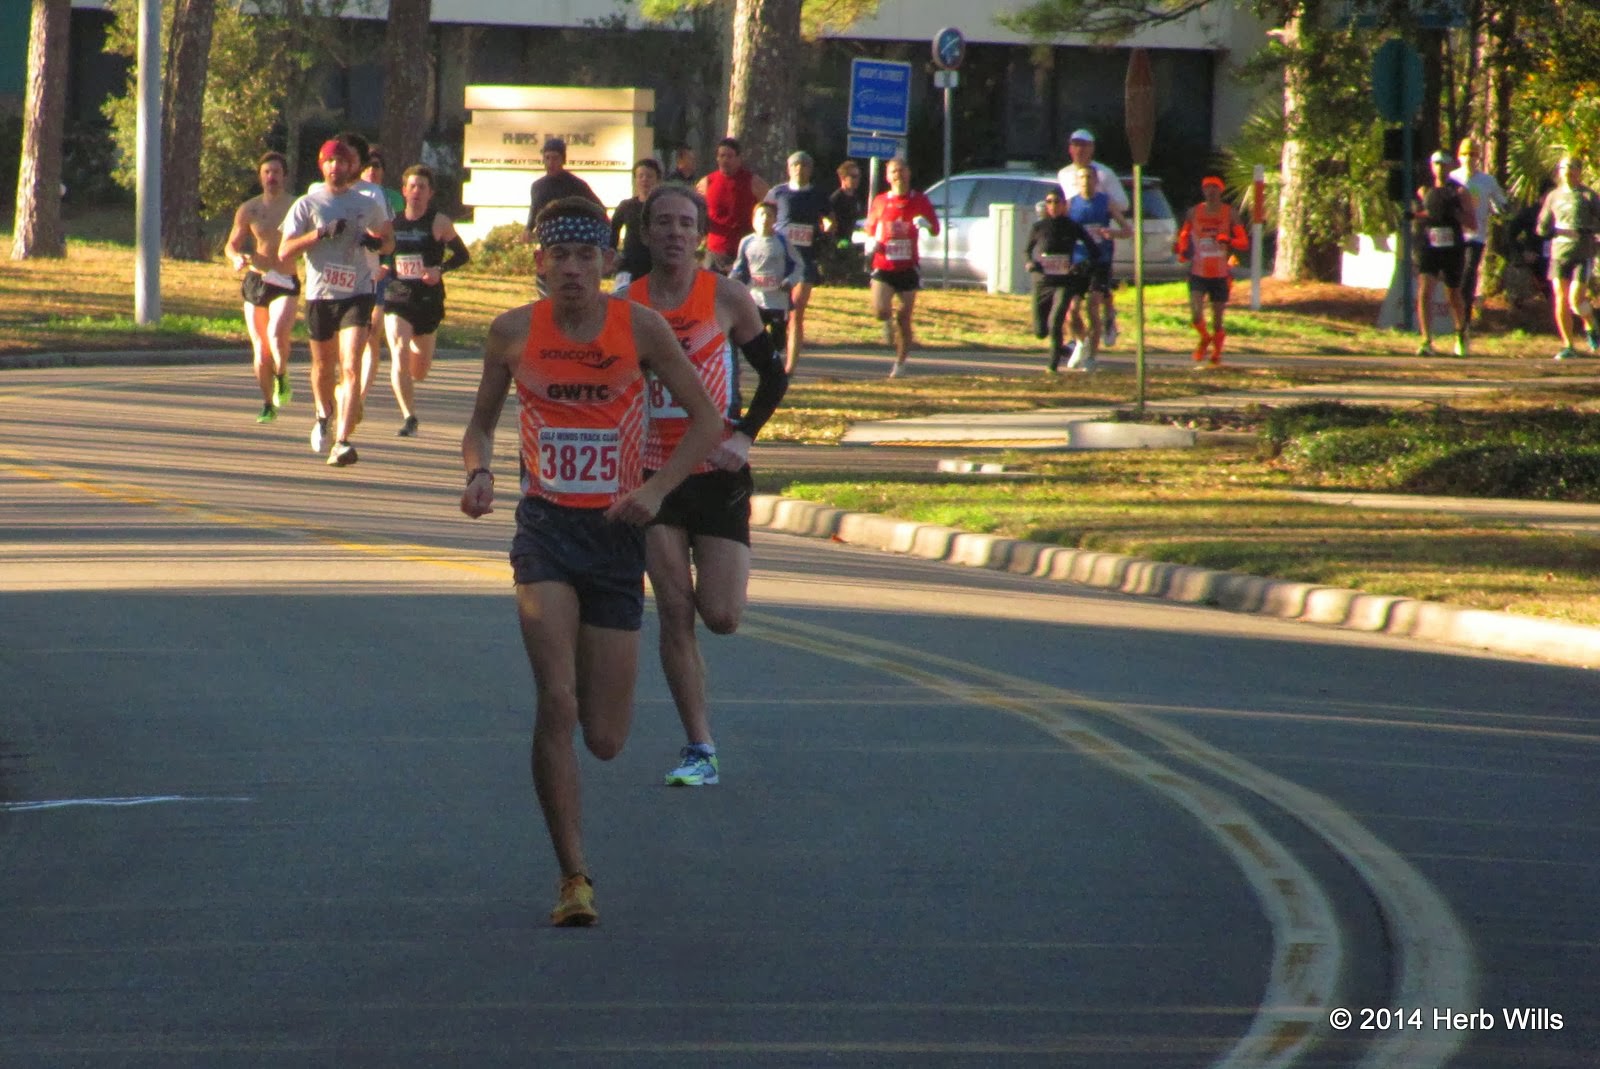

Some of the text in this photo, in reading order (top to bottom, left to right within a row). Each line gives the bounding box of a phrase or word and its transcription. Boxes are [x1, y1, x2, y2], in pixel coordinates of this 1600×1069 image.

[323, 268, 356, 289] 3852
[547, 383, 609, 400] GWTC
[541, 443, 618, 482] 3825
